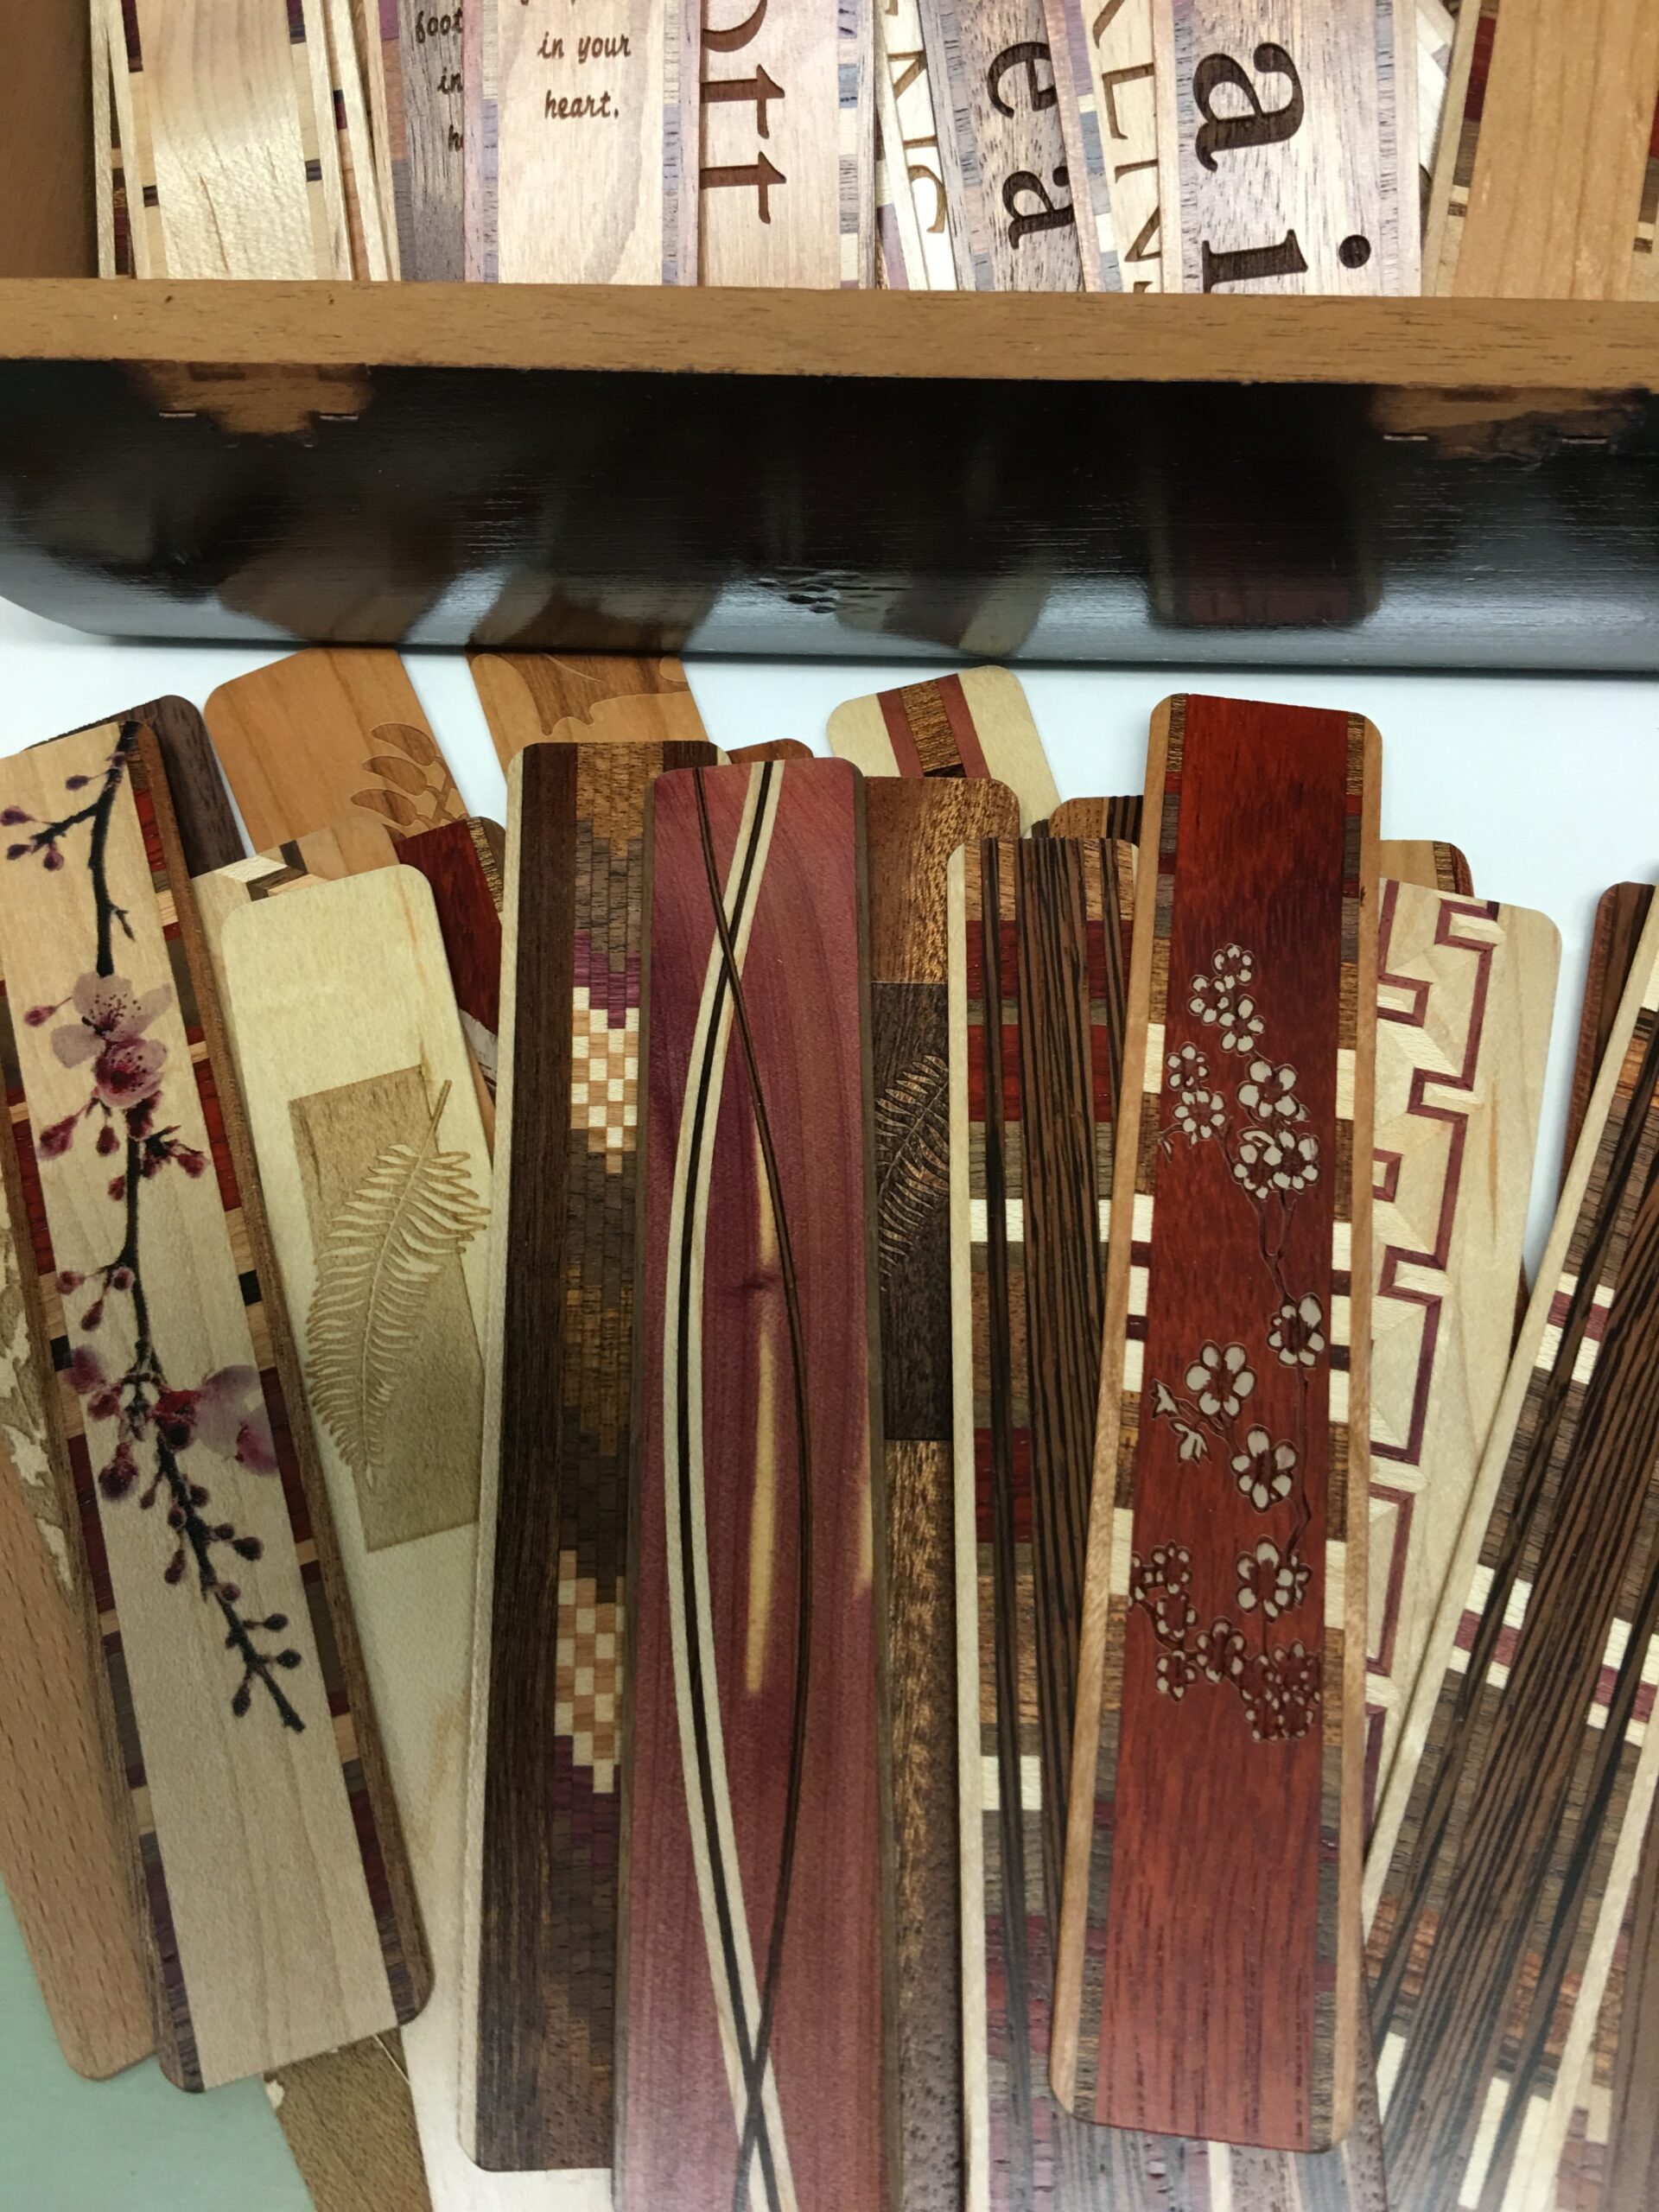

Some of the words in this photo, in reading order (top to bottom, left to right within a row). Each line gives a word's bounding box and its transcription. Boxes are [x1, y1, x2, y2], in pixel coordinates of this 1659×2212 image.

[537, 31, 564, 59] in
[577, 34, 632, 64] your
[544, 89, 620, 119] heart.
